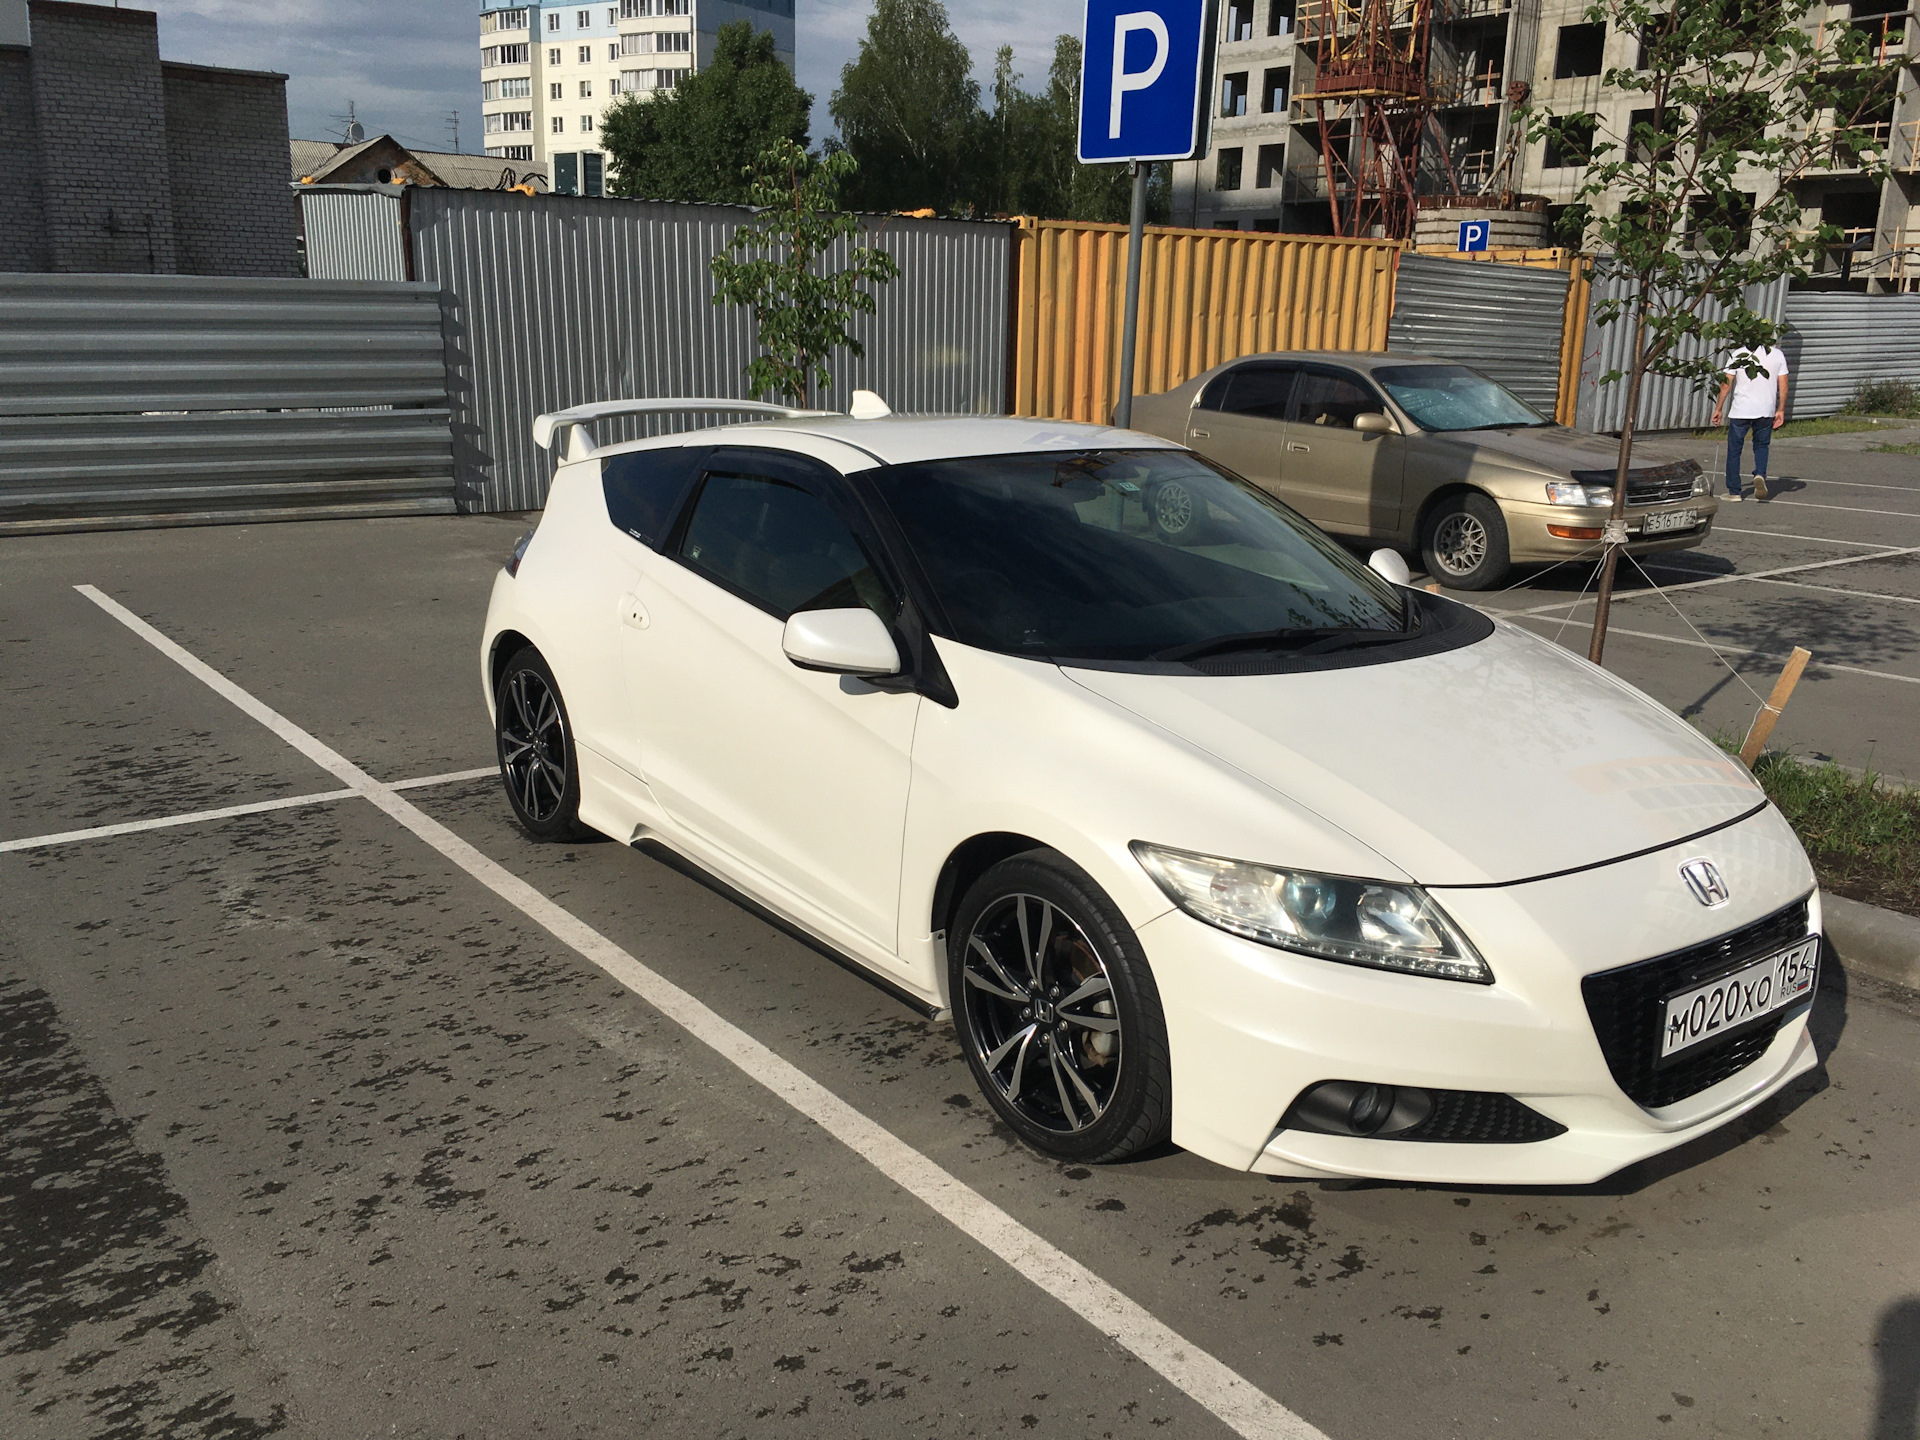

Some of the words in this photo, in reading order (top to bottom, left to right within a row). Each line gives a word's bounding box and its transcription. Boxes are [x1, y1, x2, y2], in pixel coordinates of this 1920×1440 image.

[1109, 11, 1169, 139] P
[1465, 225, 1482, 251] P
[1777, 947, 1811, 988] 154
[1780, 984, 1797, 999] RUS
